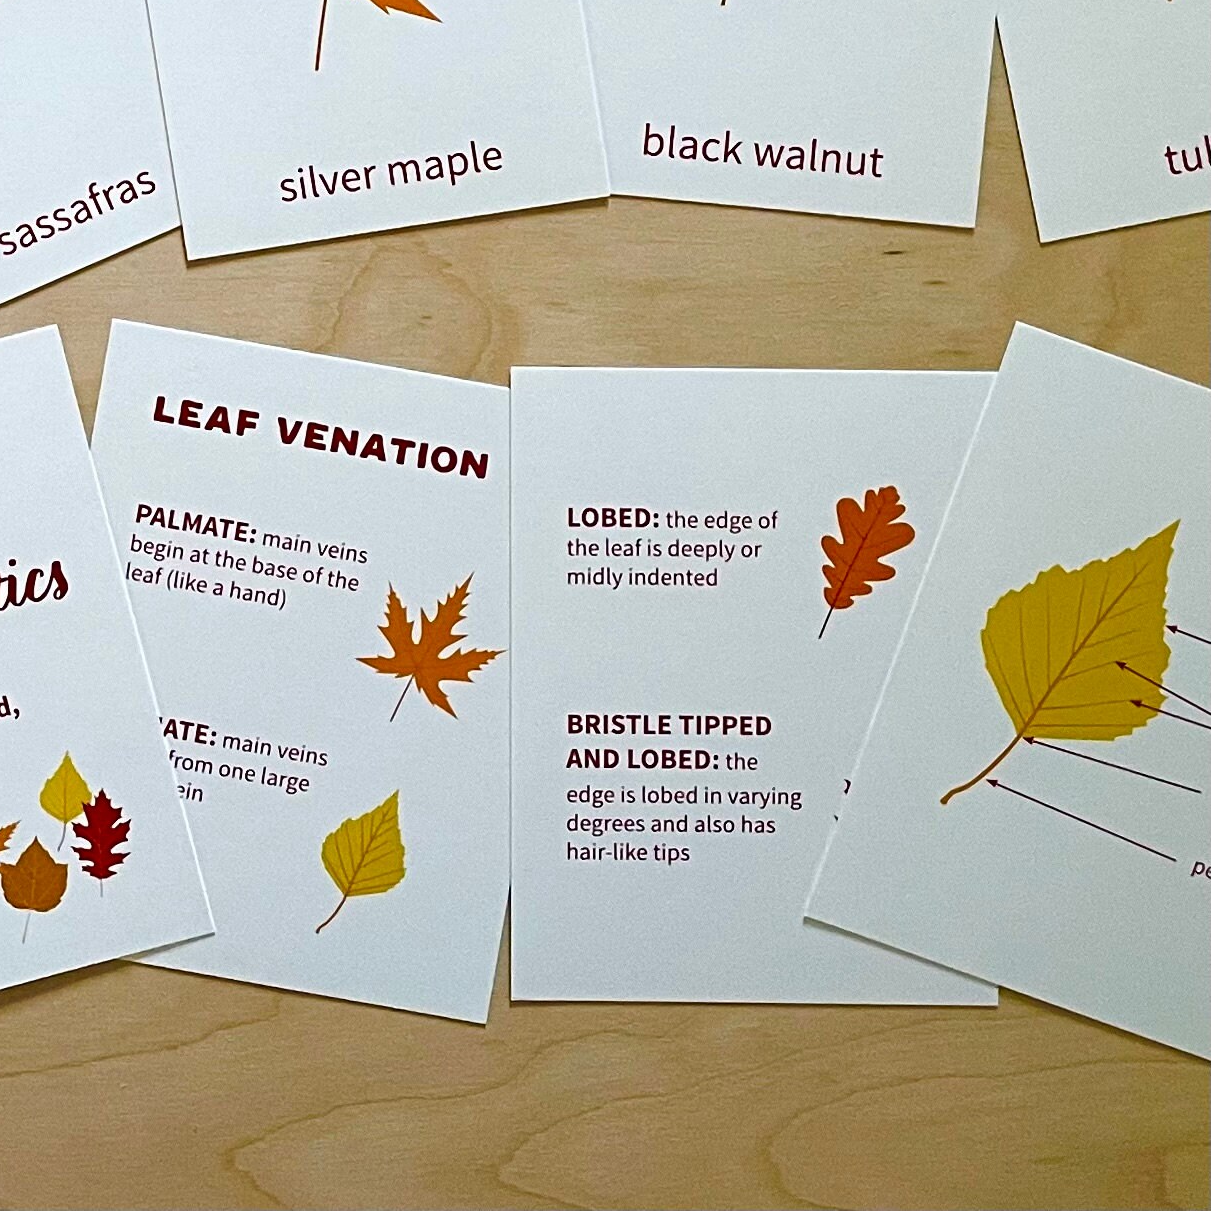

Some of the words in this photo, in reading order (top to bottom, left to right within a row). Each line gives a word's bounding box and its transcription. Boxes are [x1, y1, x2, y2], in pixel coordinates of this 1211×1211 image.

[644, 123, 743, 164] black
[754, 139, 883, 178] walnut
[281, 165, 376, 202] silver
[388, 141, 502, 186] maple
[154, 396, 259, 436] LEAF
[278, 417, 488, 479] VENATION
[136, 504, 256, 543] PALMATE:
[263, 533, 311, 553] main
[318, 543, 367, 563] veins
[568, 508, 659, 528] LOBED:
[666, 510, 698, 528] the
[705, 511, 752, 534] edge
[759, 510, 778, 529] of
[131, 534, 183, 561] begin
[190, 549, 210, 564] at
[216, 550, 246, 571] the
[252, 556, 297, 580] base
[303, 567, 324, 584] of
[328, 571, 359, 591] the
[568, 538, 599, 556] the
[606, 538, 642, 556] leaf
[648, 539, 662, 557] is
[668, 539, 735, 562] deeply
[741, 545, 762, 558] or
[126, 562, 163, 584] leaf
[167, 570, 207, 593] (like
[213, 583, 223, 596] a
[230, 581, 285, 610] hand)
[568, 567, 623, 590] midly
[629, 567, 717, 586] indented
[568, 715, 671, 734] BRISTLE
[679, 715, 771, 735] TIPPED
[159, 717, 216, 746] ATE:
[223, 736, 271, 756] main
[278, 745, 327, 766] veins
[566, 749, 619, 768] AND
[628, 749, 718, 770] LOBED:
[726, 752, 757, 770] the
[177, 782, 203, 802] ein
[219, 765, 255, 782] one
[261, 767, 309, 794] large
[567, 785, 614, 808] edge
[622, 786, 635, 803] is
[642, 786, 697, 804] lobed
[705, 787, 721, 804] in
[728, 787, 802, 810] varying
[567, 814, 645, 836] degrees
[651, 815, 687, 832] and
[695, 815, 734, 833] also
[742, 815, 775, 833] has
[568, 842, 647, 860] hair-like
[654, 843, 690, 865] tips
